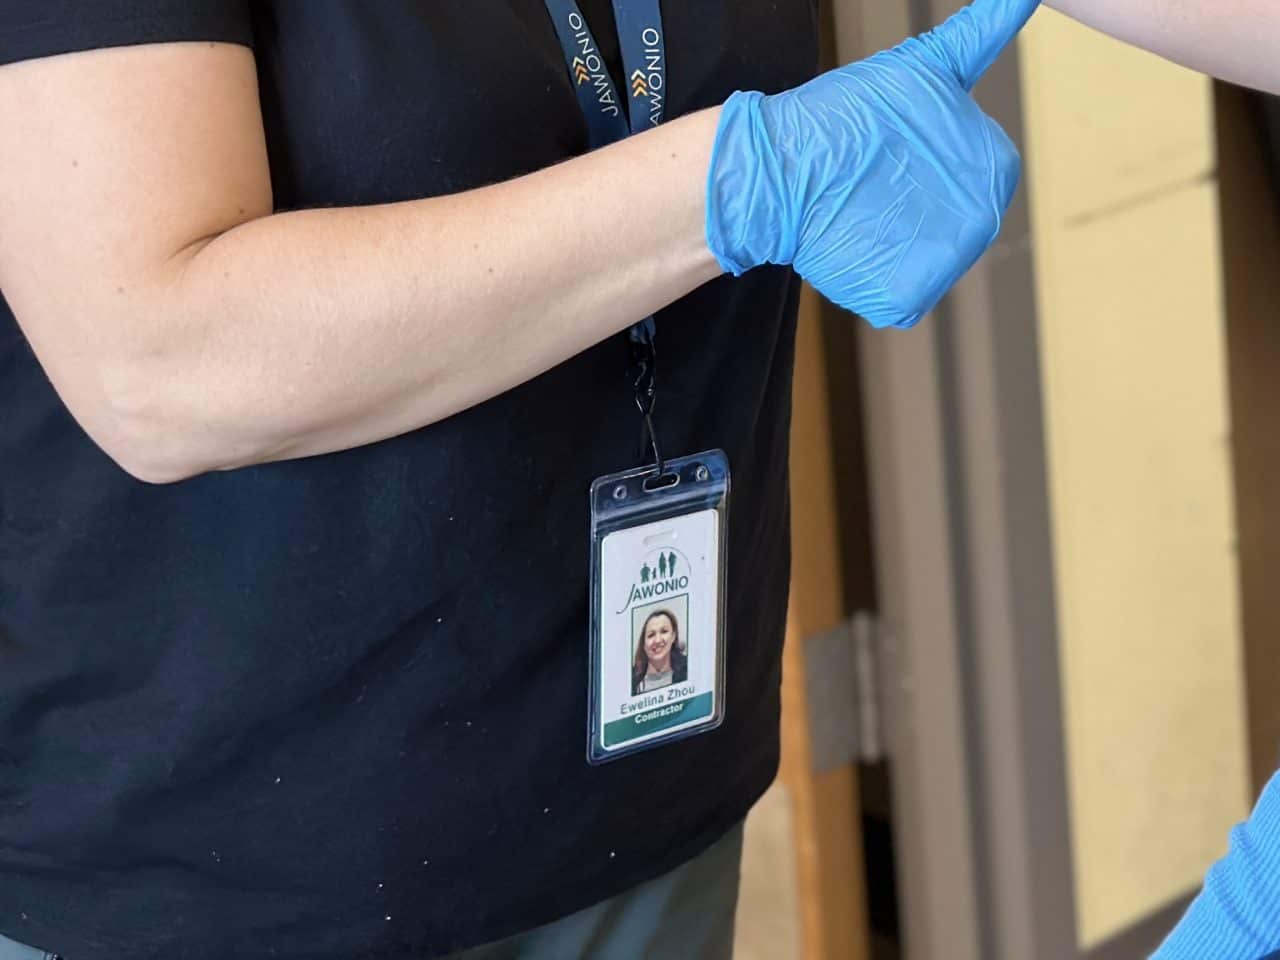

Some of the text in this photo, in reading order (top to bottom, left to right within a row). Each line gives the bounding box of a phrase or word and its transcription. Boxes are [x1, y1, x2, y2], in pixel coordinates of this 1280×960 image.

[568, 12, 619, 117] JAWONIO
[641, 28, 663, 125] AWONIO
[616, 575, 689, 615] JAWONIO
[620, 685, 695, 715] Ewelina Zhou
[634, 703, 685, 724] Contractor
